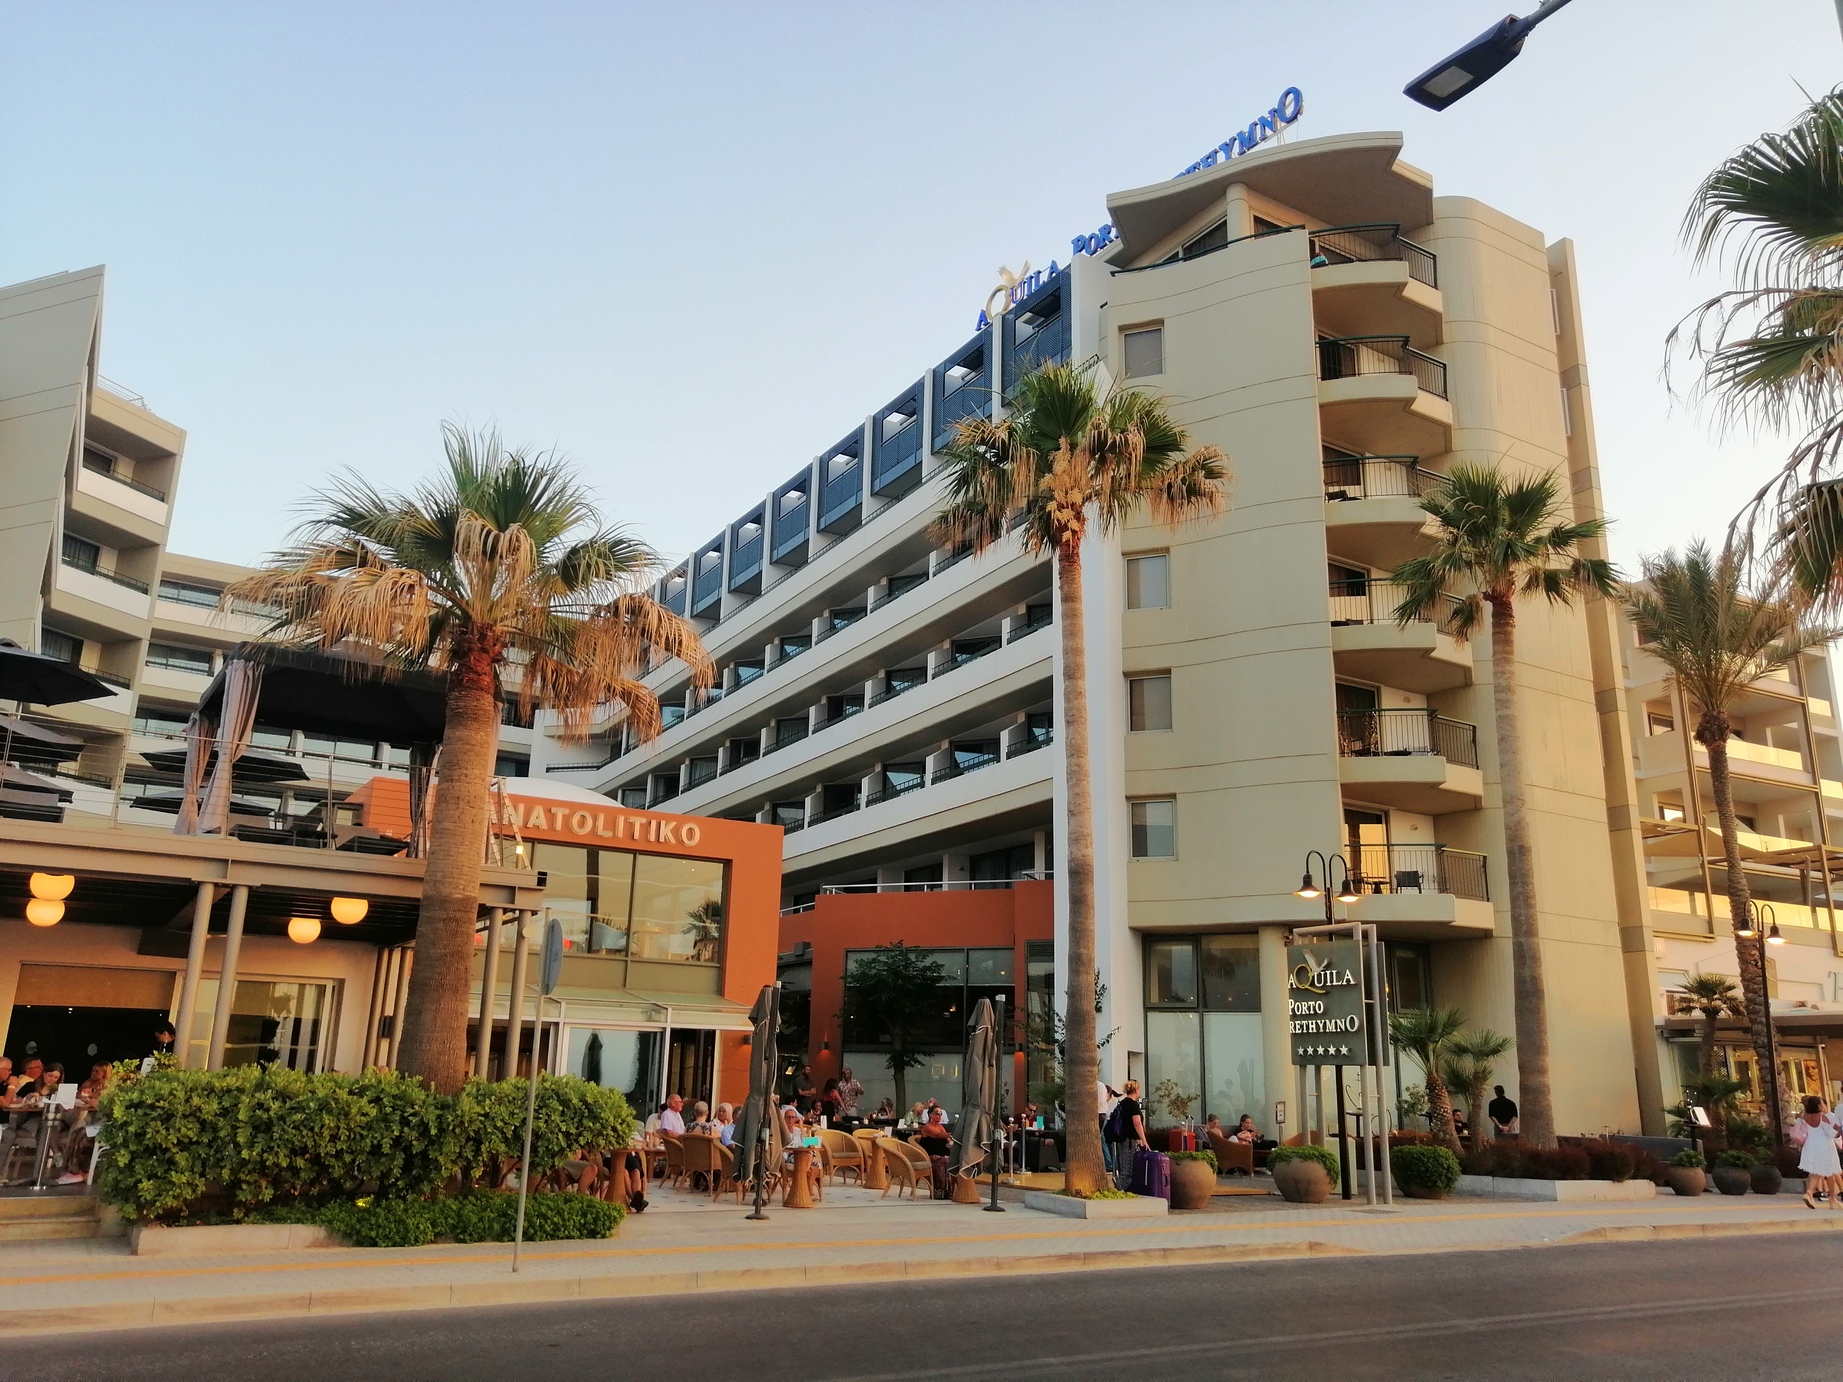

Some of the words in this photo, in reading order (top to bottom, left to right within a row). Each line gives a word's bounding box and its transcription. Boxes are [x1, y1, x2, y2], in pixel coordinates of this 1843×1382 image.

[975, 259, 1062, 332] AQUILA
[1288, 963, 1357, 994] AQUILA
[1288, 999, 1324, 1015] PORTO
[1290, 1014, 1360, 1034] RETHYMNO
